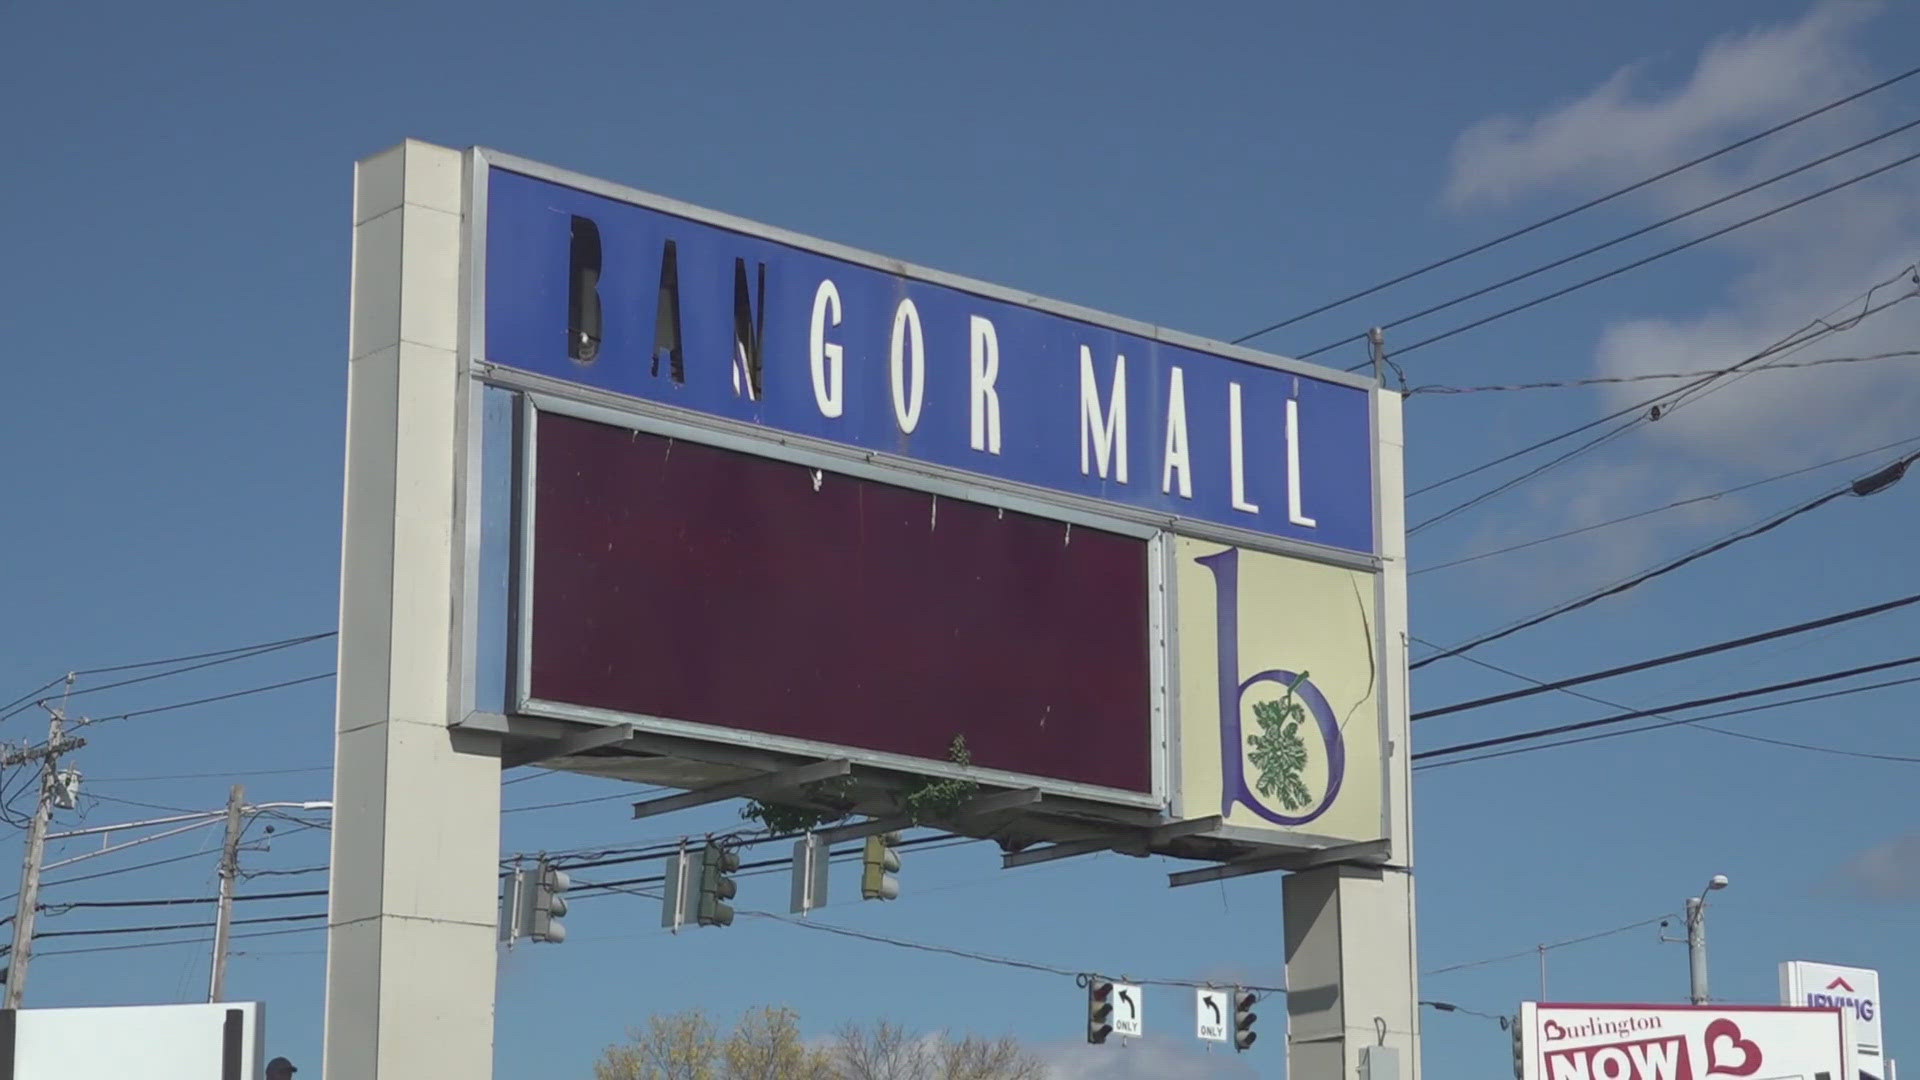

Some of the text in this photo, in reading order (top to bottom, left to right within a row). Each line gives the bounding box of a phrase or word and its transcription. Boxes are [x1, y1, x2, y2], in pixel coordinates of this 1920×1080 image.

[568, 214, 1317, 527] BANGOR MALL
[1116, 1020, 1138, 1032] ONLY
[1200, 1025, 1222, 1037] ONLY
[1544, 1016, 1662, 1041] Burlington
[1550, 1040, 1680, 1080] NOW
